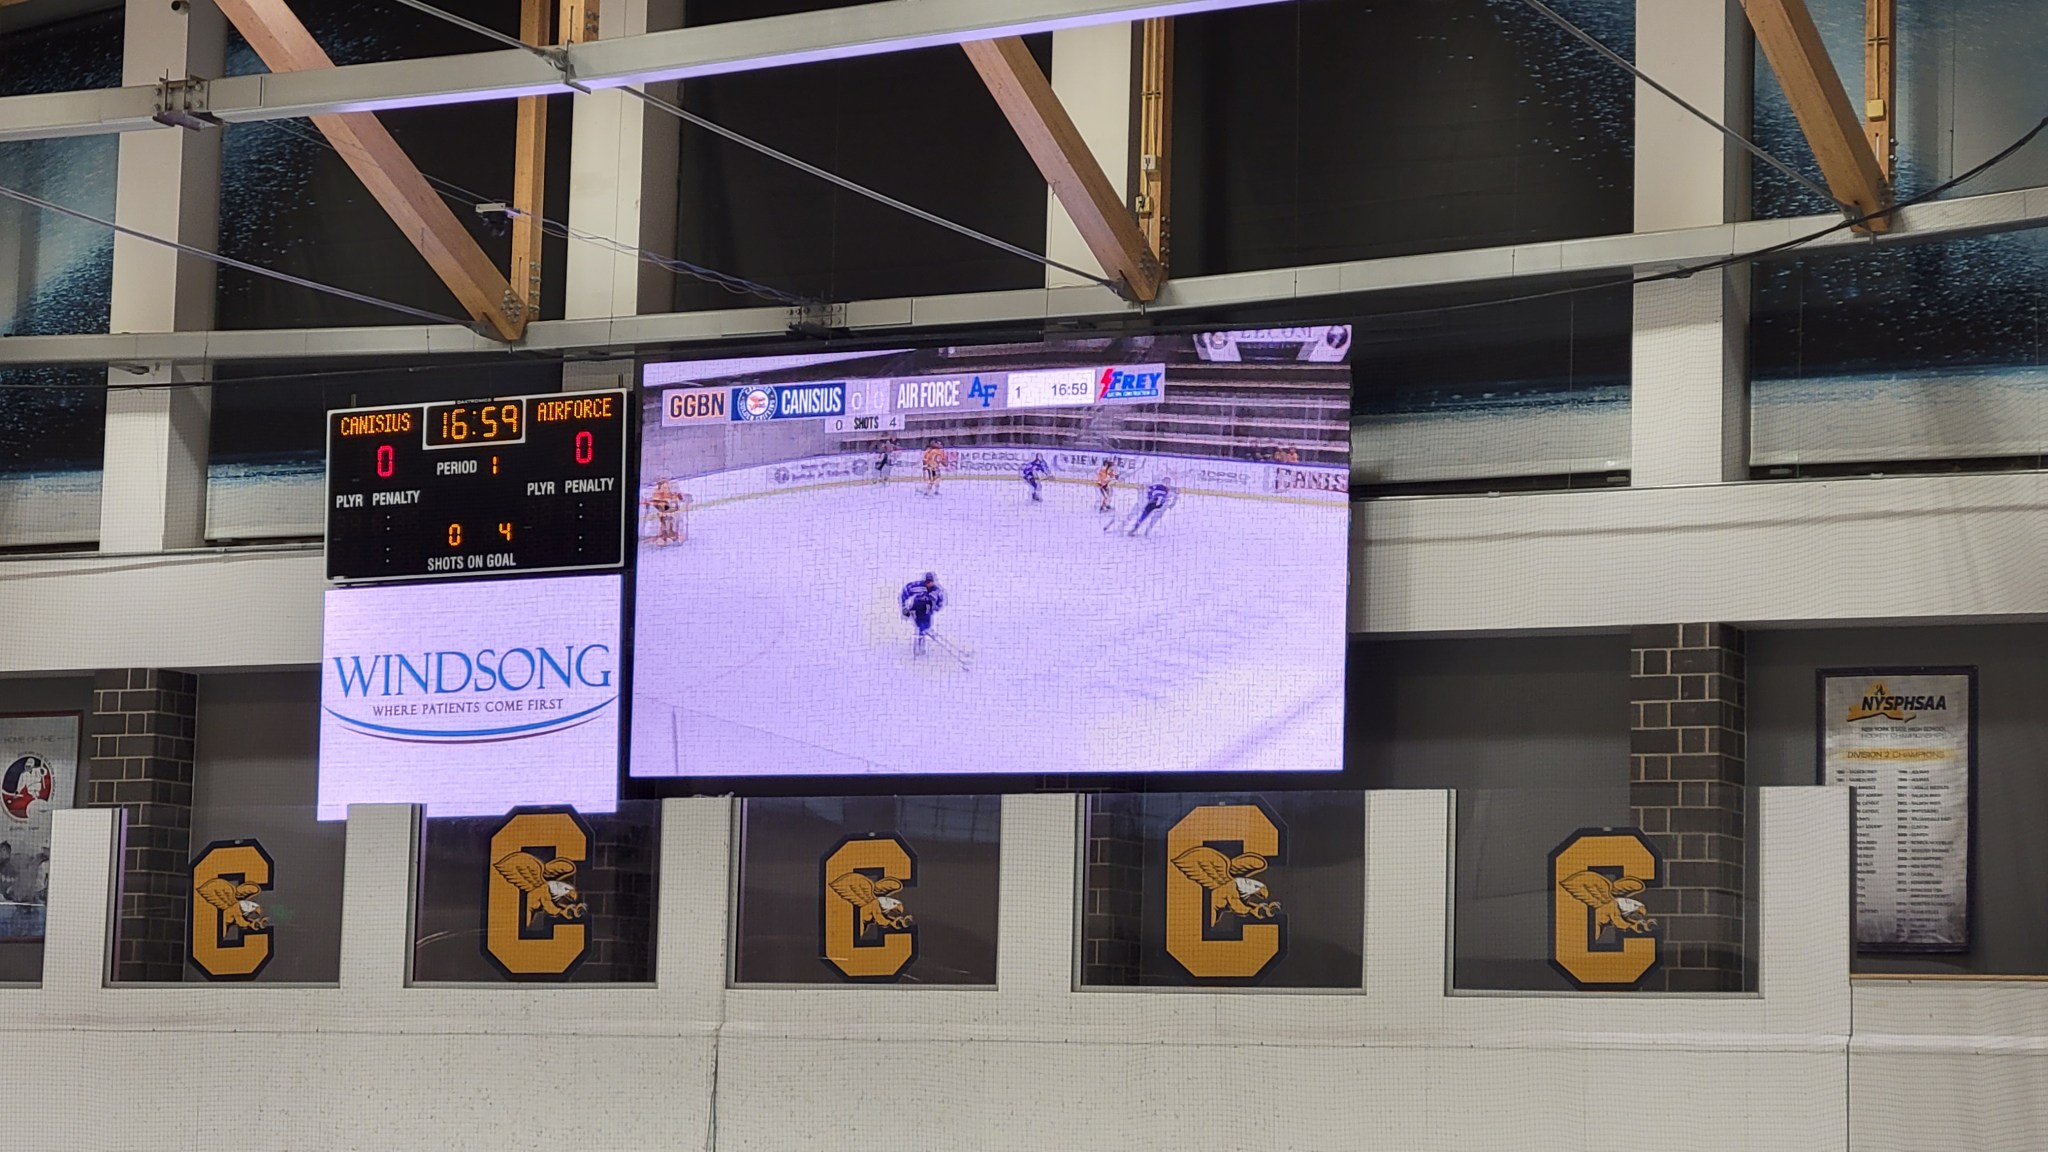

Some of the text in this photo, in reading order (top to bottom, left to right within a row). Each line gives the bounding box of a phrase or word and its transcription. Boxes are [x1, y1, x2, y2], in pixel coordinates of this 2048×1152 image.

[1051, 382, 1088, 396] 16:59
[1108, 370, 1163, 390] FREY
[781, 387, 842, 415] CANISIUS
[896, 380, 961, 409] AIR FORCE
[967, 376, 998, 407] AF
[1015, 386, 1021, 399] 1
[537, 397, 612, 422] AIRFORCE
[669, 392, 725, 418] GGBN
[340, 412, 411, 436] CANISIUS
[442, 404, 518, 440] 16:59
[835, 416, 897, 431] 0 SHOTS 4
[575, 431, 593, 464] 0
[377, 445, 394, 478] 0
[436, 459, 478, 476] PERIOD
[492, 455, 499, 475] 1
[527, 477, 614, 496] PLYR PENALTY
[335, 490, 421, 508] PLYR PENALTY
[449, 523, 462, 546] 0
[498, 522, 512, 541] 4
[427, 553, 517, 571] SHOTS ON GOAL
[332, 644, 612, 699] WINDSONG
[372, 698, 564, 717] WHERE PATIENTS COME FIRST
[1861, 695, 1947, 711] NYSPHSAA
